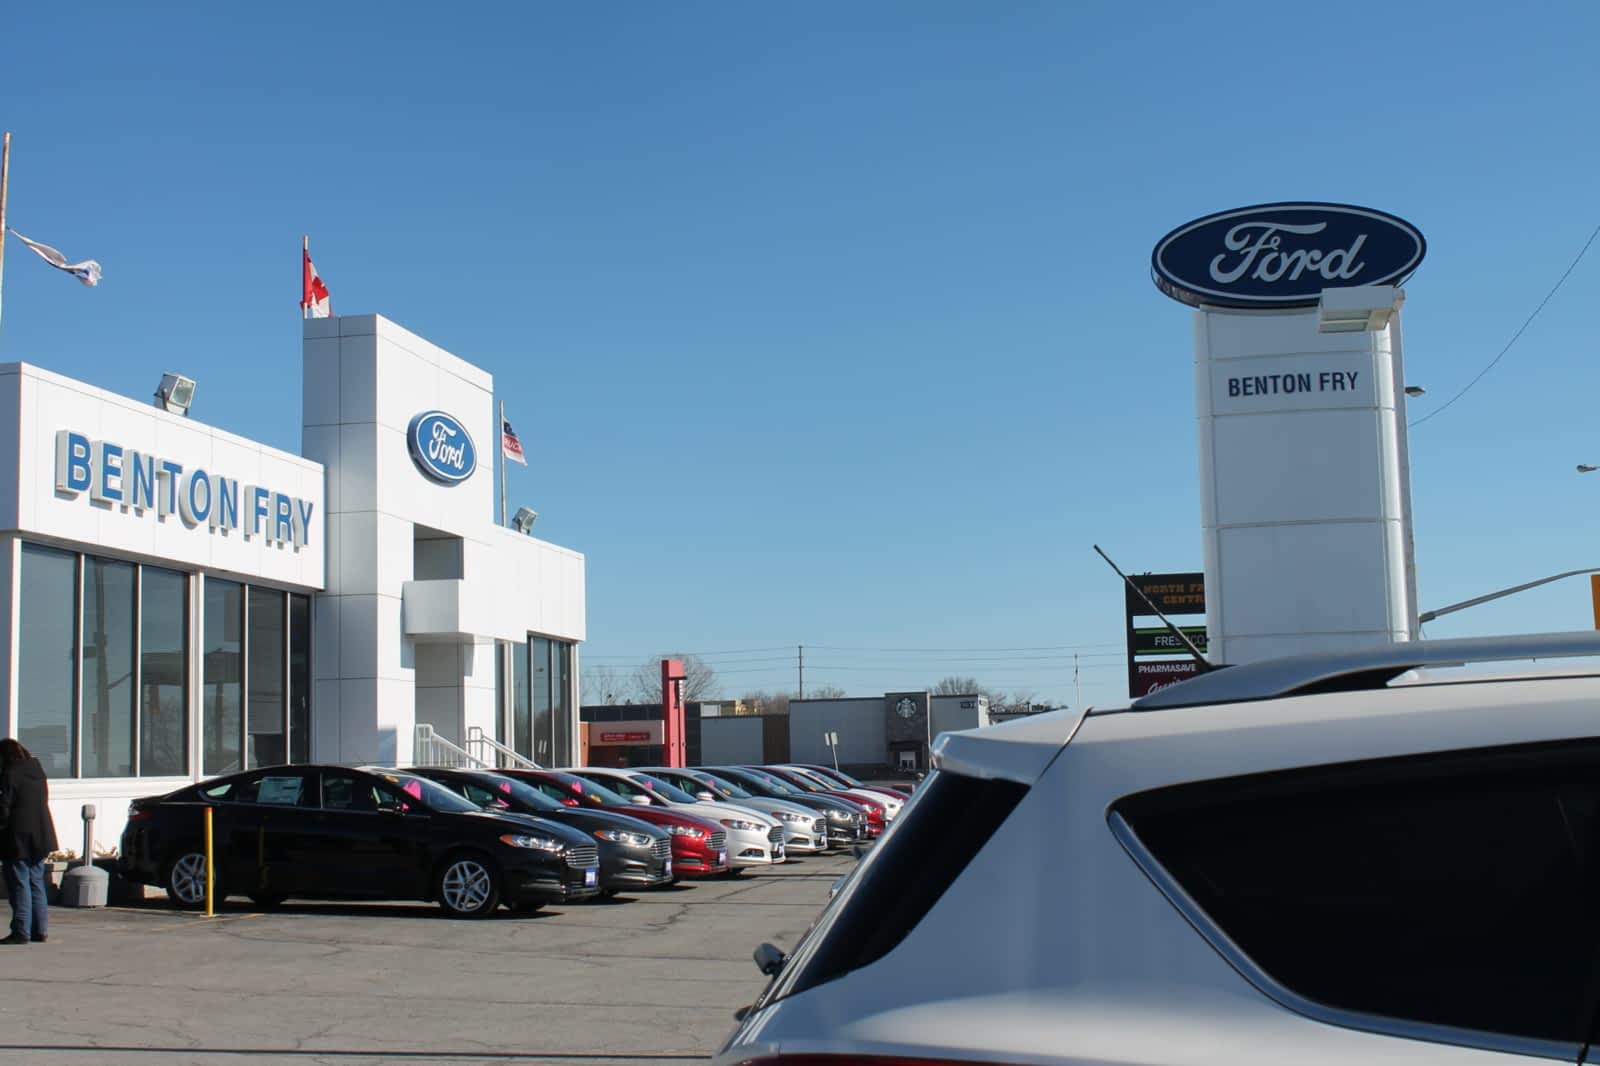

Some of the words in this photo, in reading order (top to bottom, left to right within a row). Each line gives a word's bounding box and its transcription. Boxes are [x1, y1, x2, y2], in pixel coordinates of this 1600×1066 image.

[1209, 221, 1368, 284] Ford
[1228, 374, 1311, 397] BENTON
[1319, 371, 1359, 392] FRY
[428, 421, 465, 470] Ford
[55, 430, 239, 530] BENTON
[244, 485, 314, 548] FRY
[1143, 584, 1184, 593] NORTH
[1163, 594, 1204, 604] CENTR
[1154, 634, 1206, 646] FRECO
[1138, 663, 1196, 673] PHARMASAVE
